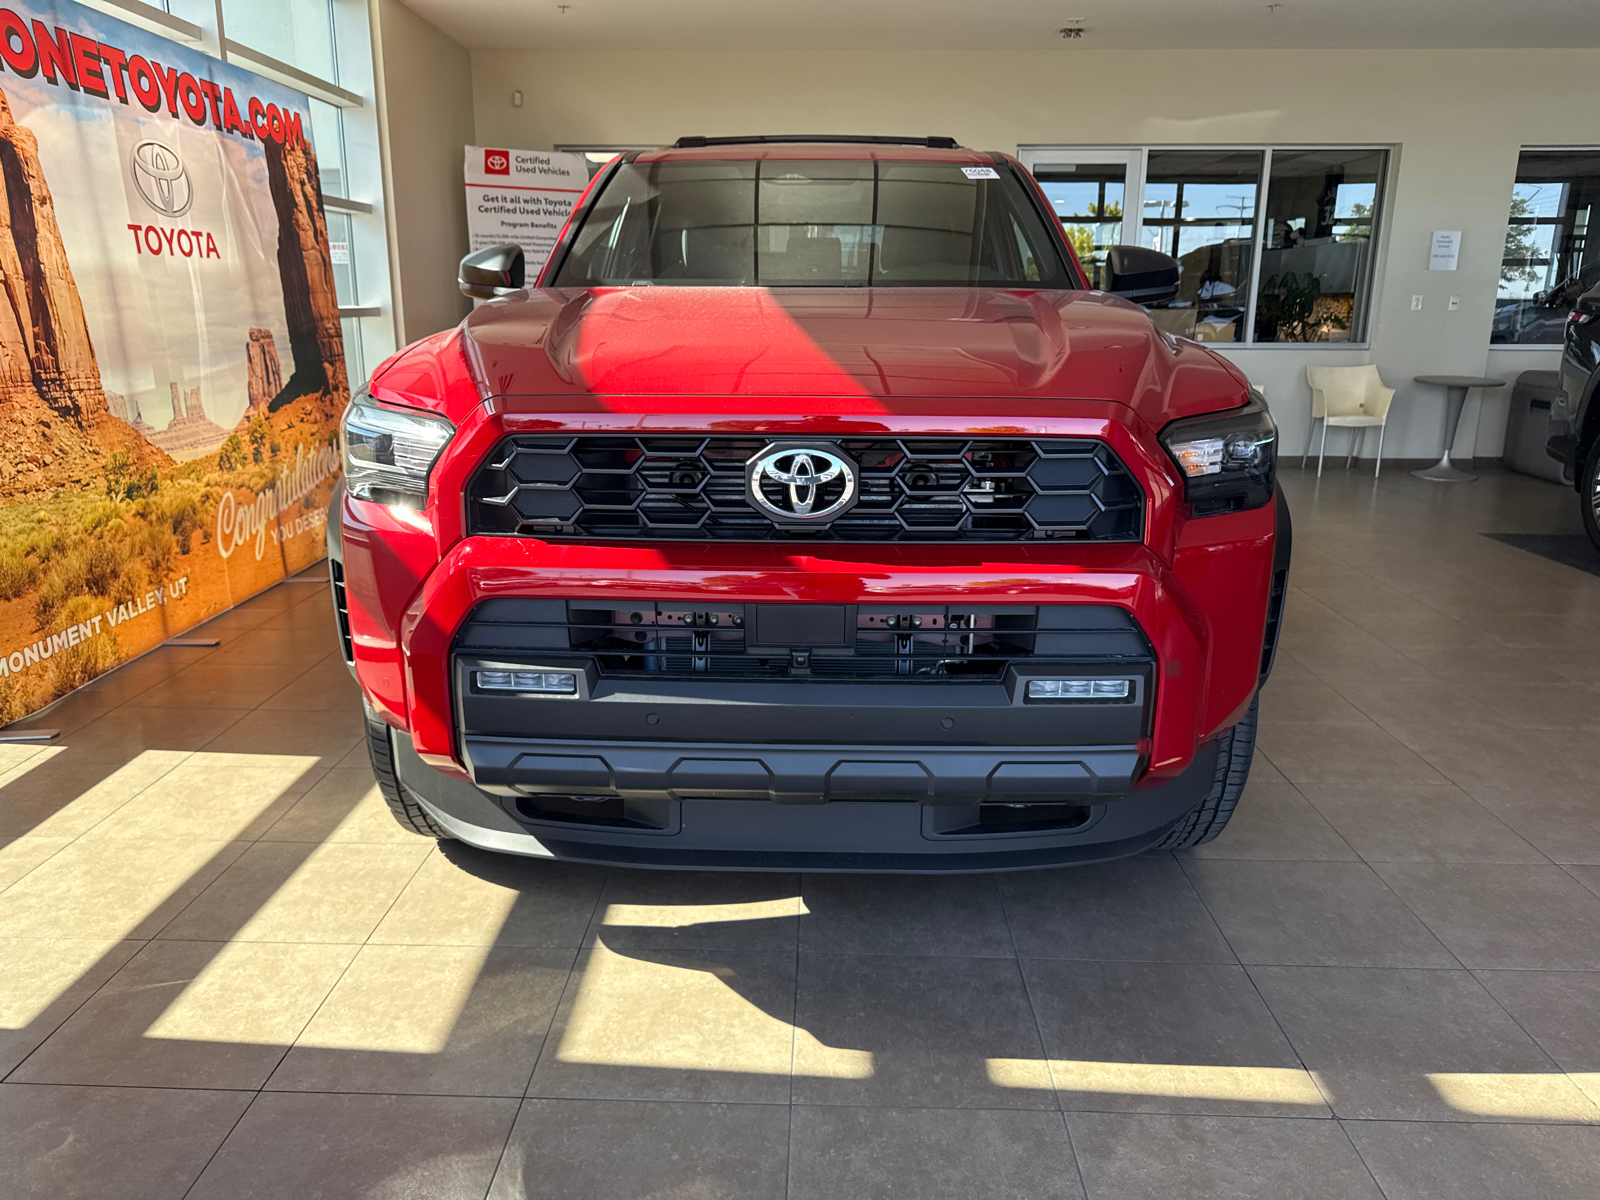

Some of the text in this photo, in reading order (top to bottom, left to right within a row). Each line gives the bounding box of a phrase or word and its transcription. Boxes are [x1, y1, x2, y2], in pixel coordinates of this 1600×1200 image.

[515, 155, 551, 165] Certified
[515, 165, 571, 176] Used Vehicles
[482, 194, 572, 208] Get it all with Toyota
[478, 204, 517, 214] Certified
[519, 206, 541, 216] Used
[500, 220, 557, 230] Program Benefits
[127, 223, 222, 260] TOYOTA
[217, 438, 341, 561] Congratulations
[270, 521, 294, 546] YOU
[105, 586, 168, 628] VALLEY,
[168, 576, 188, 599] UT
